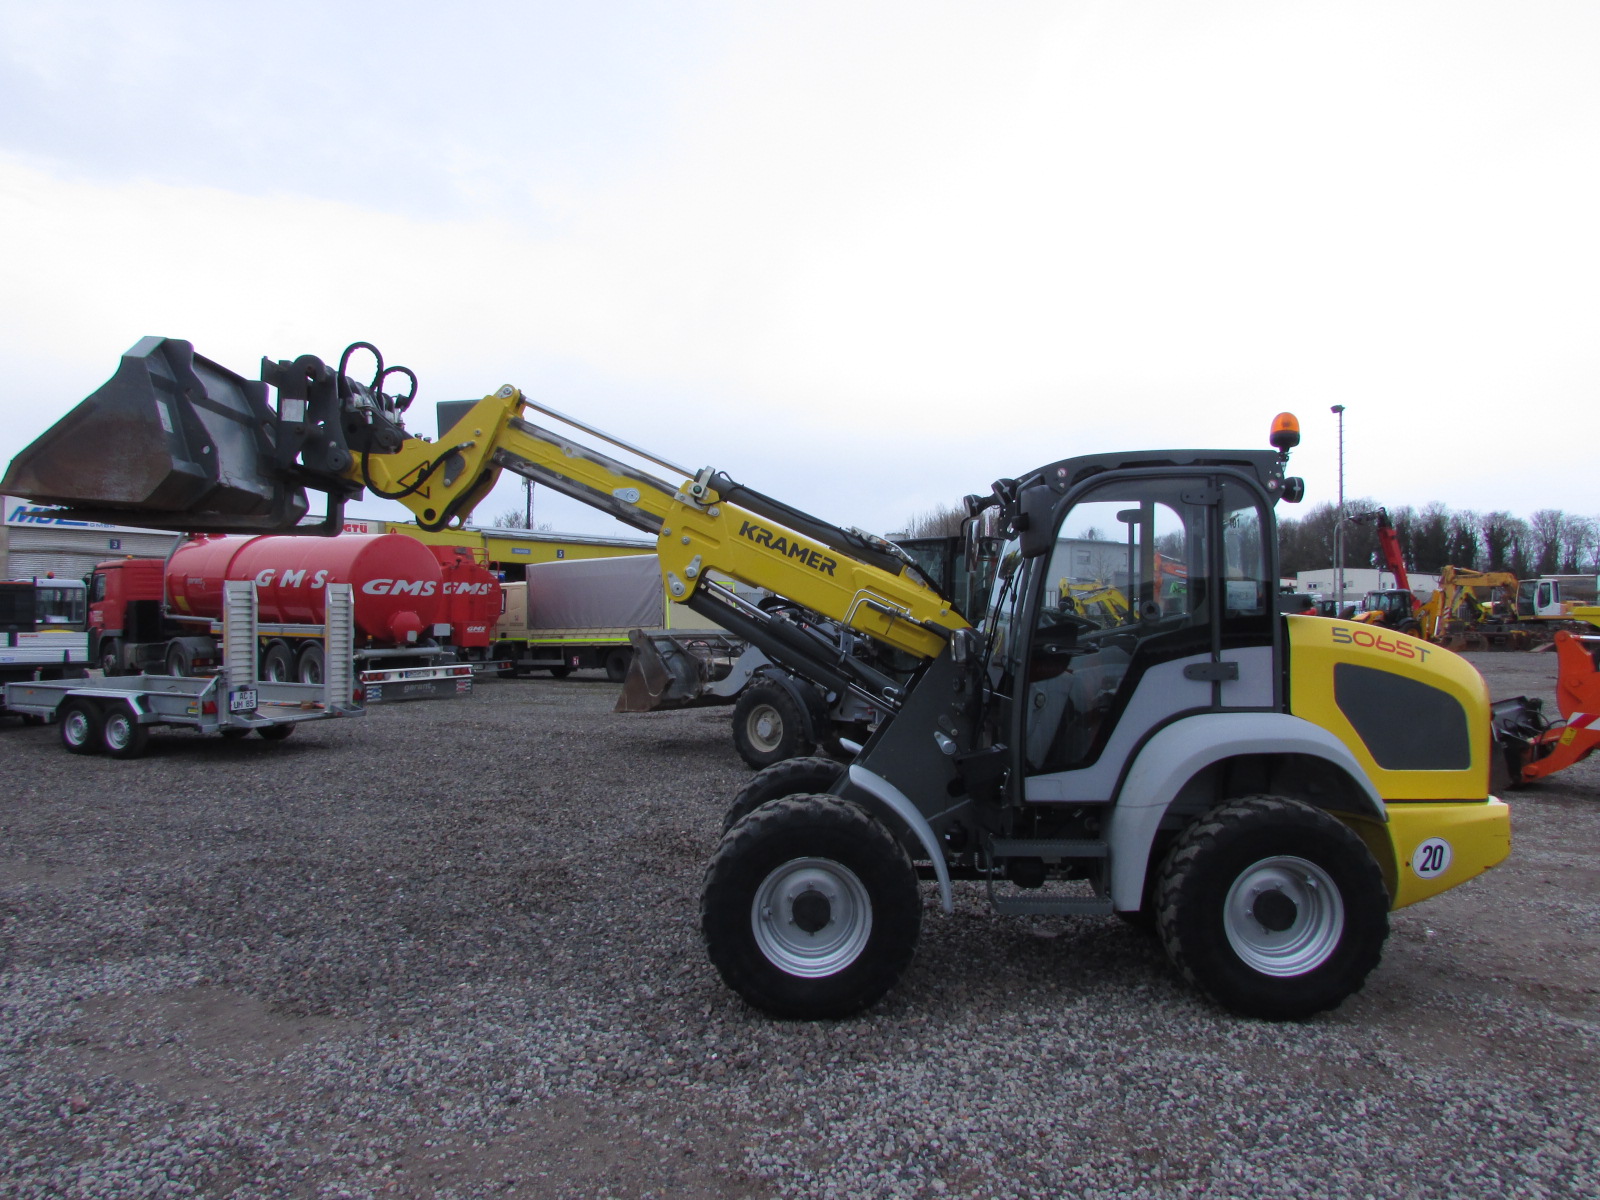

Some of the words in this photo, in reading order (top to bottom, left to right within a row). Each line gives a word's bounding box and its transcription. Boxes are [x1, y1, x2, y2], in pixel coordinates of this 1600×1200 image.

[558, 550, 563, 558] 5
[738, 521, 837, 577] KRAMER
[361, 578, 437, 597] GMS
[442, 581, 493, 596] GMS
[1331, 626, 1431, 663] 5065T
[1419, 844, 1444, 872] 20
